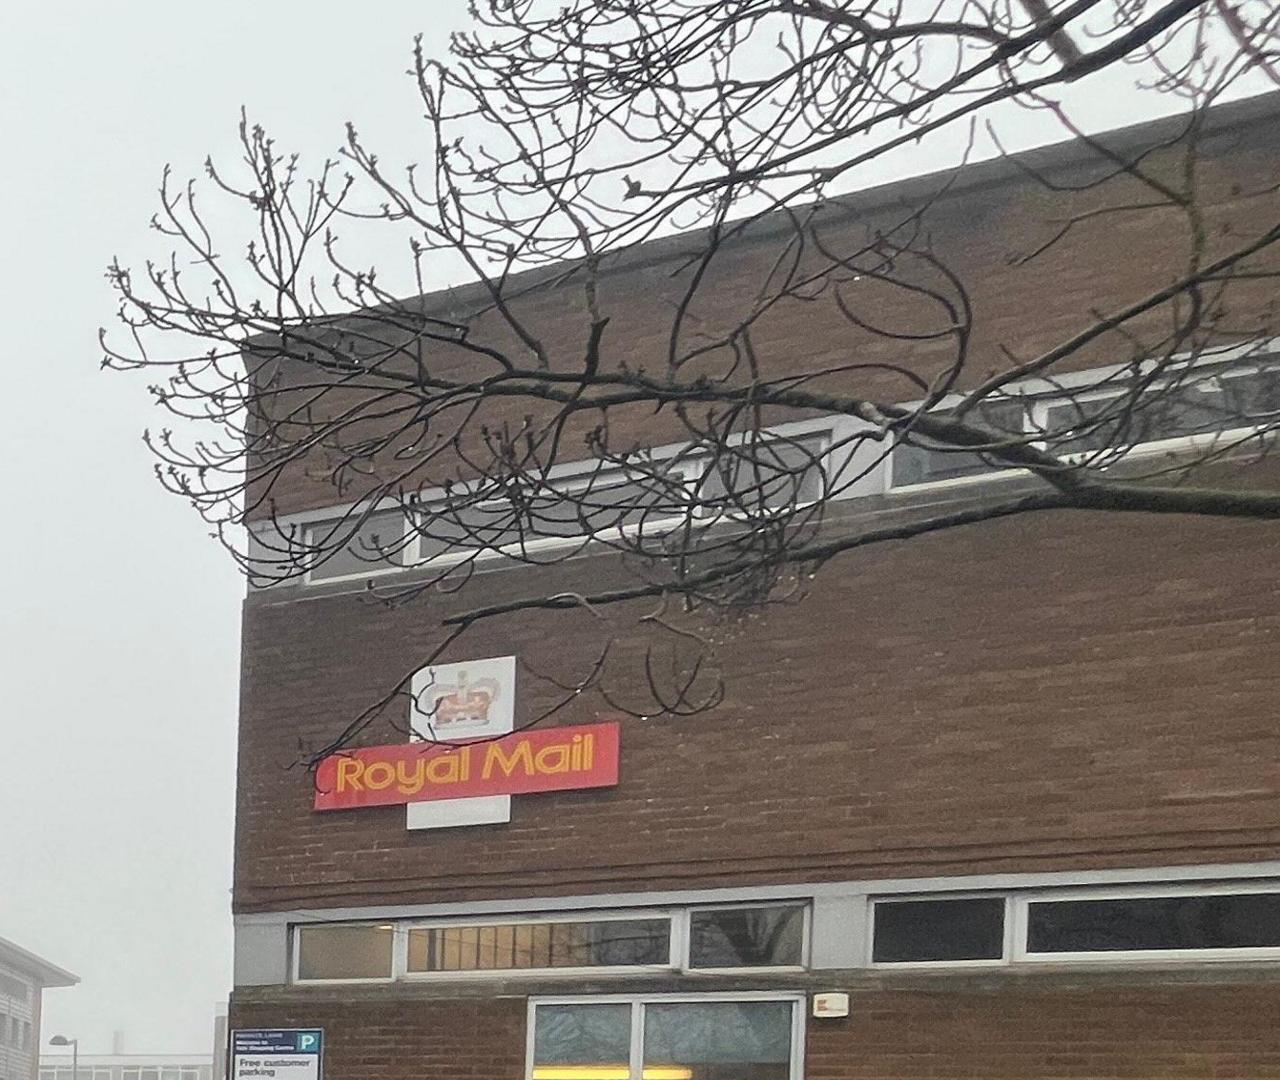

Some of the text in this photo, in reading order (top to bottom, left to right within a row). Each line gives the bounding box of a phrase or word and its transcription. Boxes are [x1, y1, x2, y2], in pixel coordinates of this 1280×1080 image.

[336, 733, 594, 795] Royal Mail
[301, 1034, 315, 1050] P
[239, 1058, 310, 1067] Free customer
[239, 1068, 275, 1077] parking
